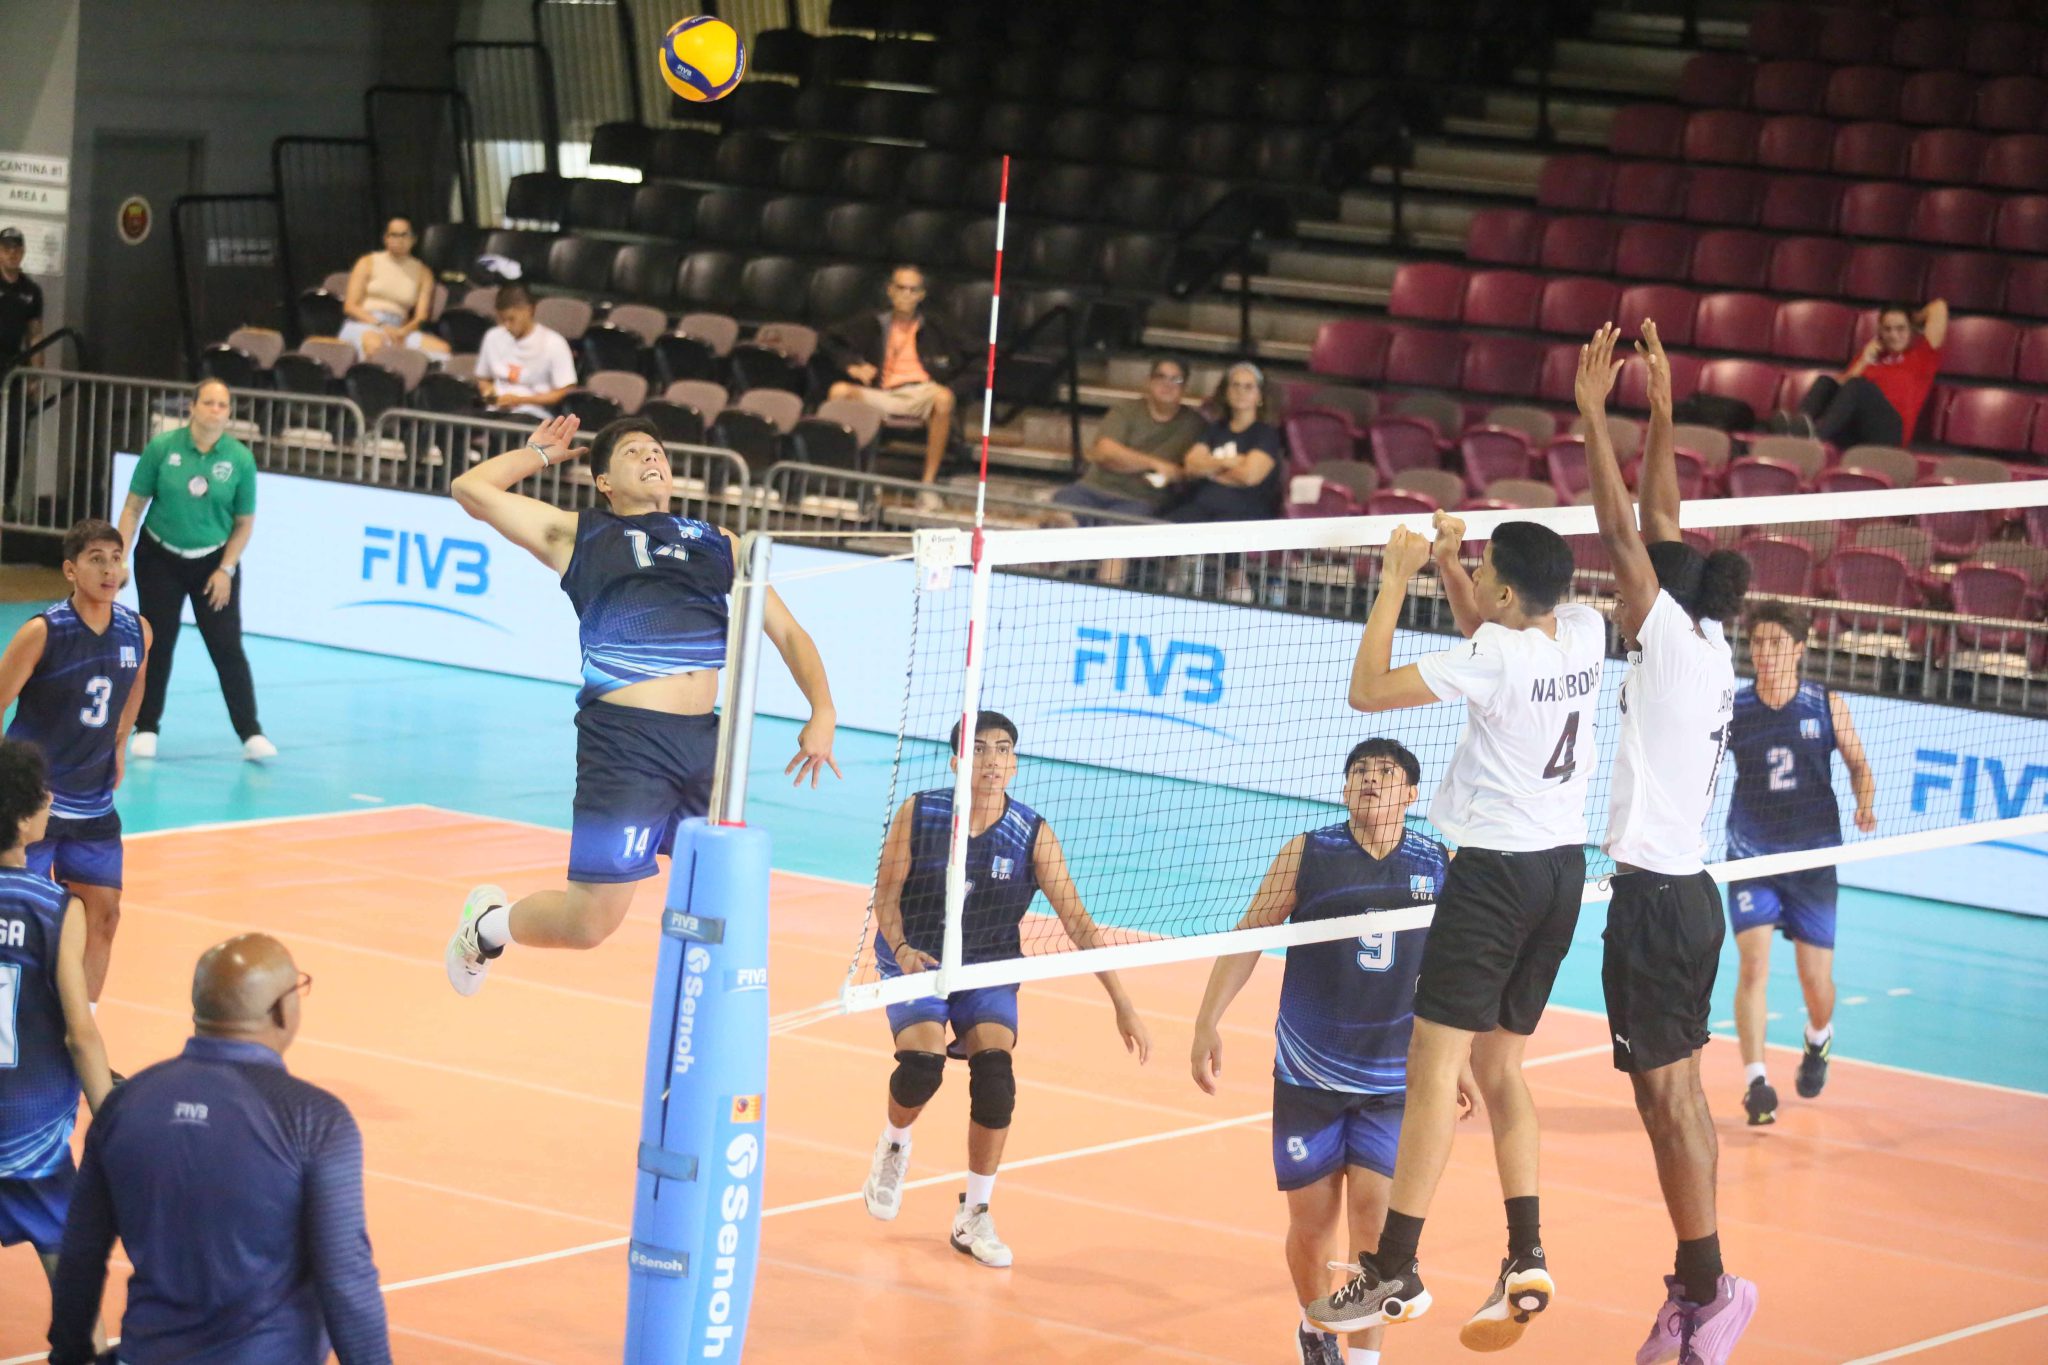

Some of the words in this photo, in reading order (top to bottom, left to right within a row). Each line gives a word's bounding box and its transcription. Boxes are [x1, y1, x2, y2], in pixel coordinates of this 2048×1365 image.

[10, 189, 37, 201] AREA
[362, 526, 490, 596] FIVB
[1072, 626, 1226, 705] FIVB
[80, 676, 113, 728] 3
[1542, 710, 1580, 784] 4
[1766, 747, 1798, 792] 2
[623, 826, 651, 858] 14
[991, 871, 1011, 880] GUA
[1412, 892, 1434, 902] GUA
[1737, 891, 1754, 912] 2
[672, 912, 699, 931] FIVB
[1357, 907, 1397, 972] 9
[675, 976, 704, 1074] Senoh
[174, 1102, 208, 1120] FIVB
[1286, 1136, 1309, 1162] 9
[639, 1254, 683, 1272] Senoh
[703, 1184, 749, 1358] Senoh
